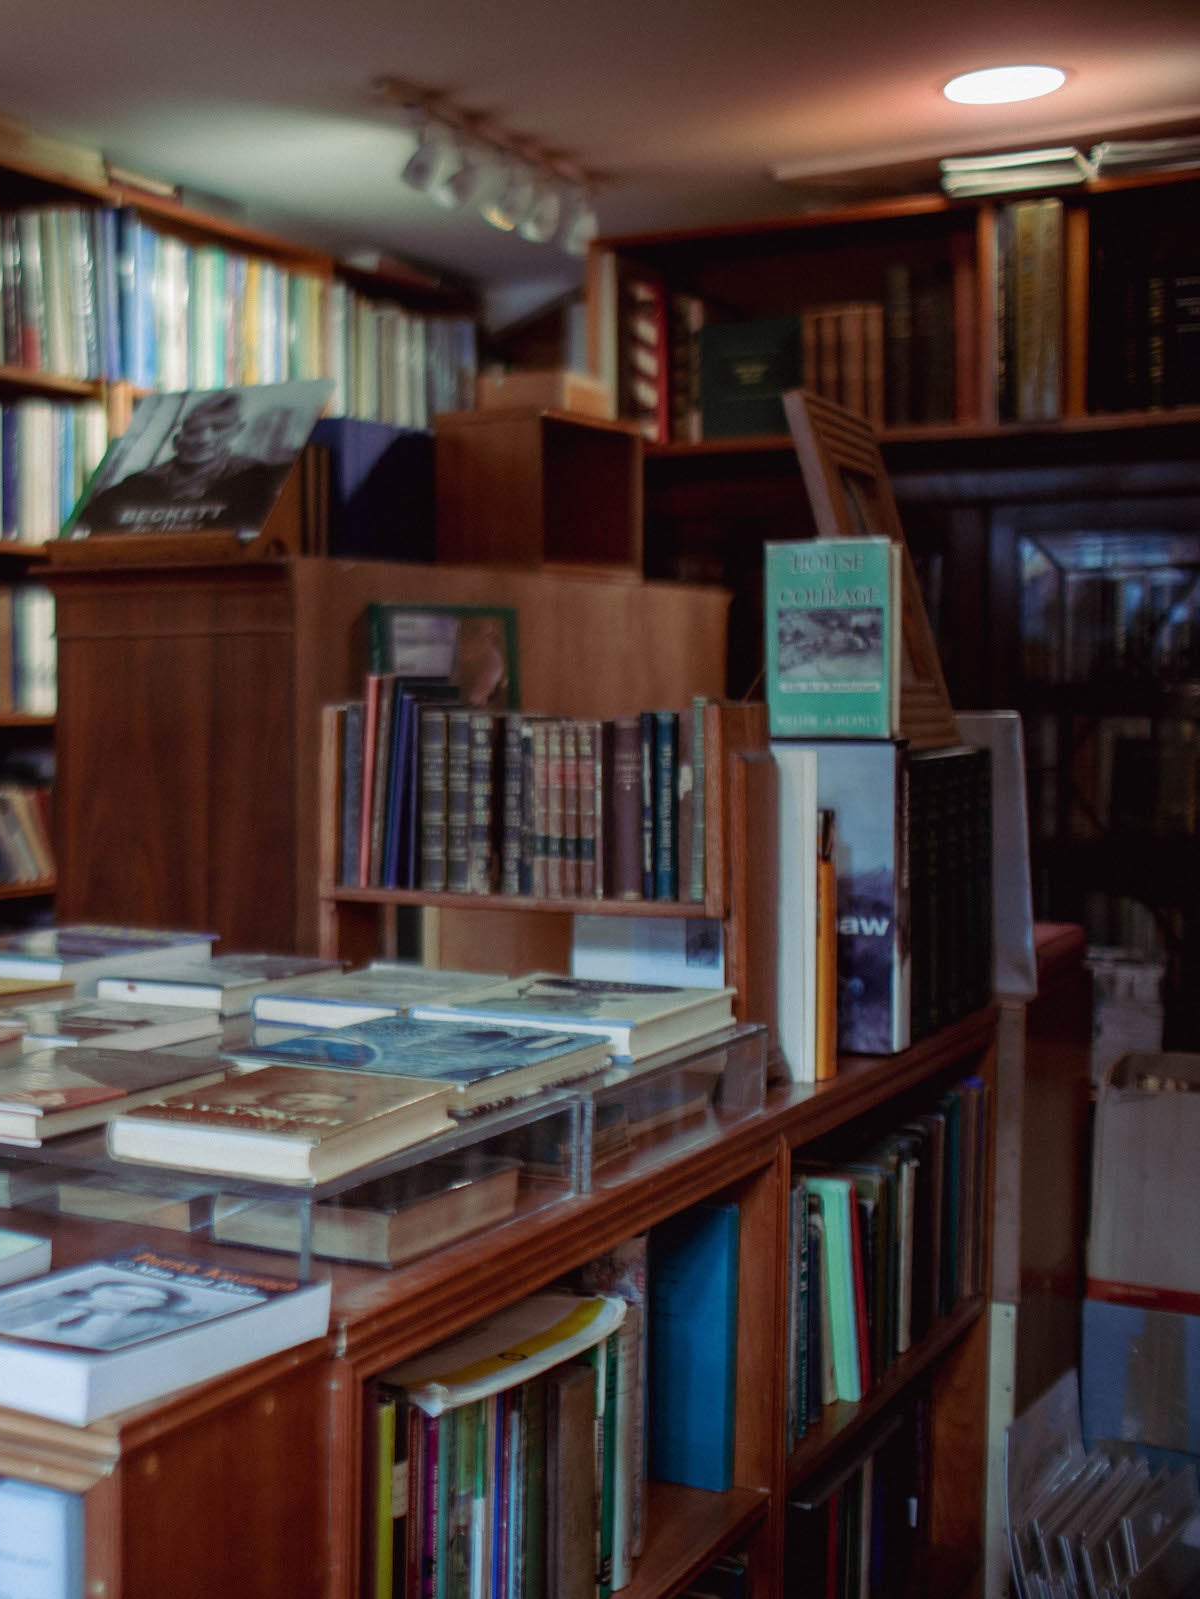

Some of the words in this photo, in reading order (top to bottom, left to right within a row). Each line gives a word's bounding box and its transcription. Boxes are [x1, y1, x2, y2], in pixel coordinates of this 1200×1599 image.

[119, 504, 227, 524] BECKETT
[788, 552, 863, 574] HOUSE
[776, 586, 879, 605] COURAGE
[837, 915, 890, 937] aw
